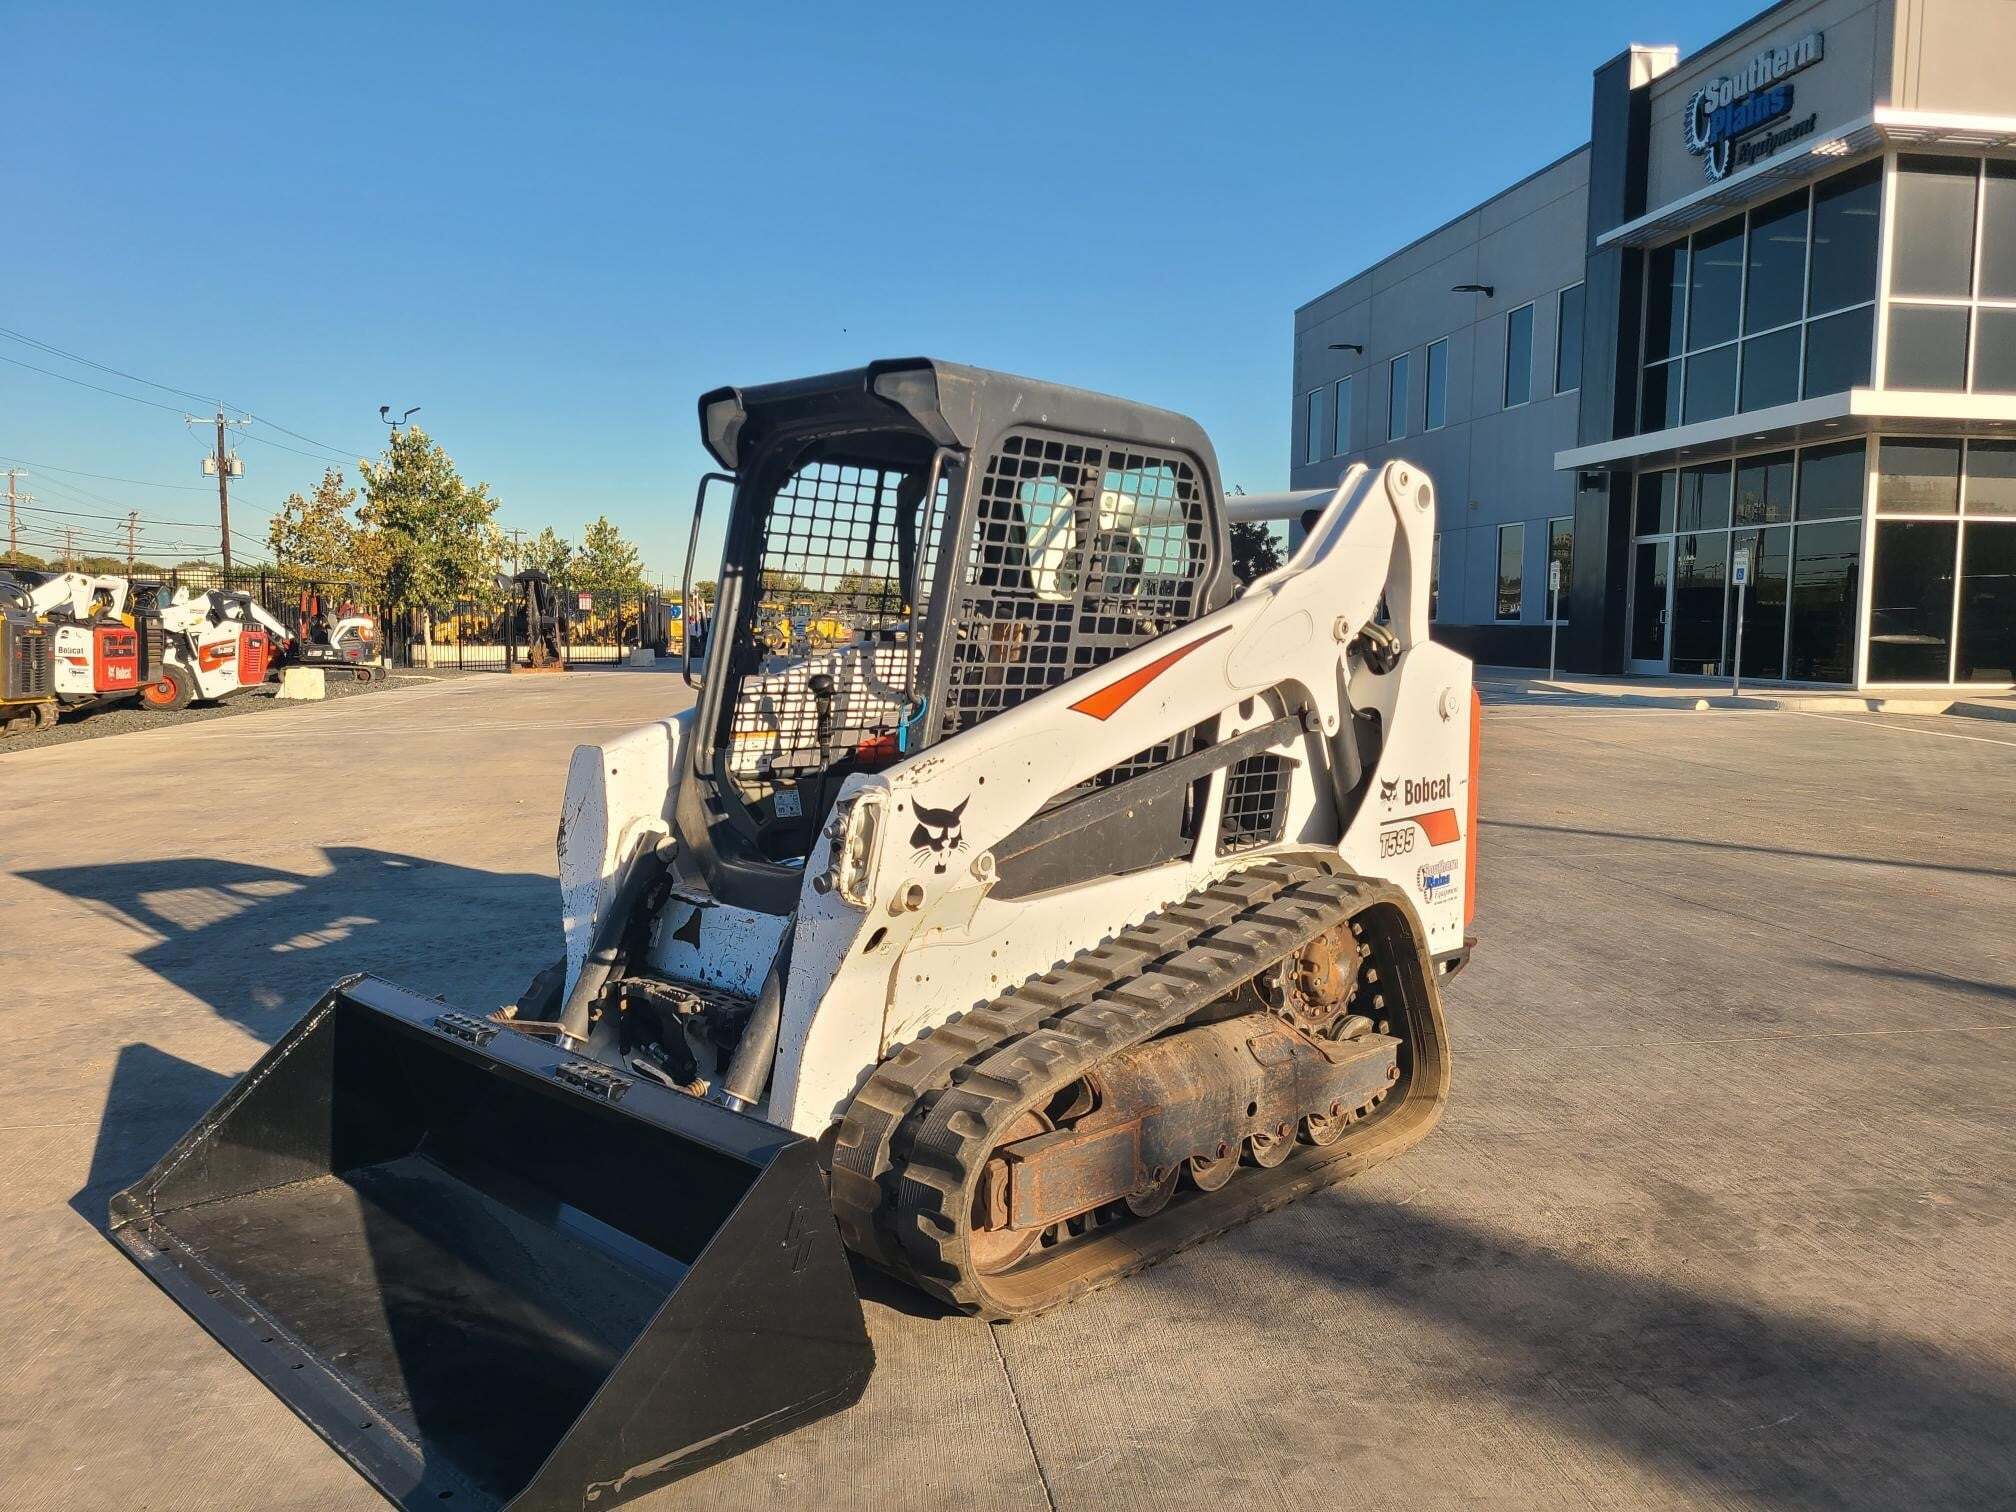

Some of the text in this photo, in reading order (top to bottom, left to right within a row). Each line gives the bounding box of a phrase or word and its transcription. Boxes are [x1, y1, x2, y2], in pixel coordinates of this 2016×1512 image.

[1703, 30, 1824, 115] Southern
[1709, 83, 1794, 145] Plains
[58, 646, 84, 655] Bobcat
[1404, 773, 1451, 806] Bobcat
[1380, 827, 1415, 858] T595
